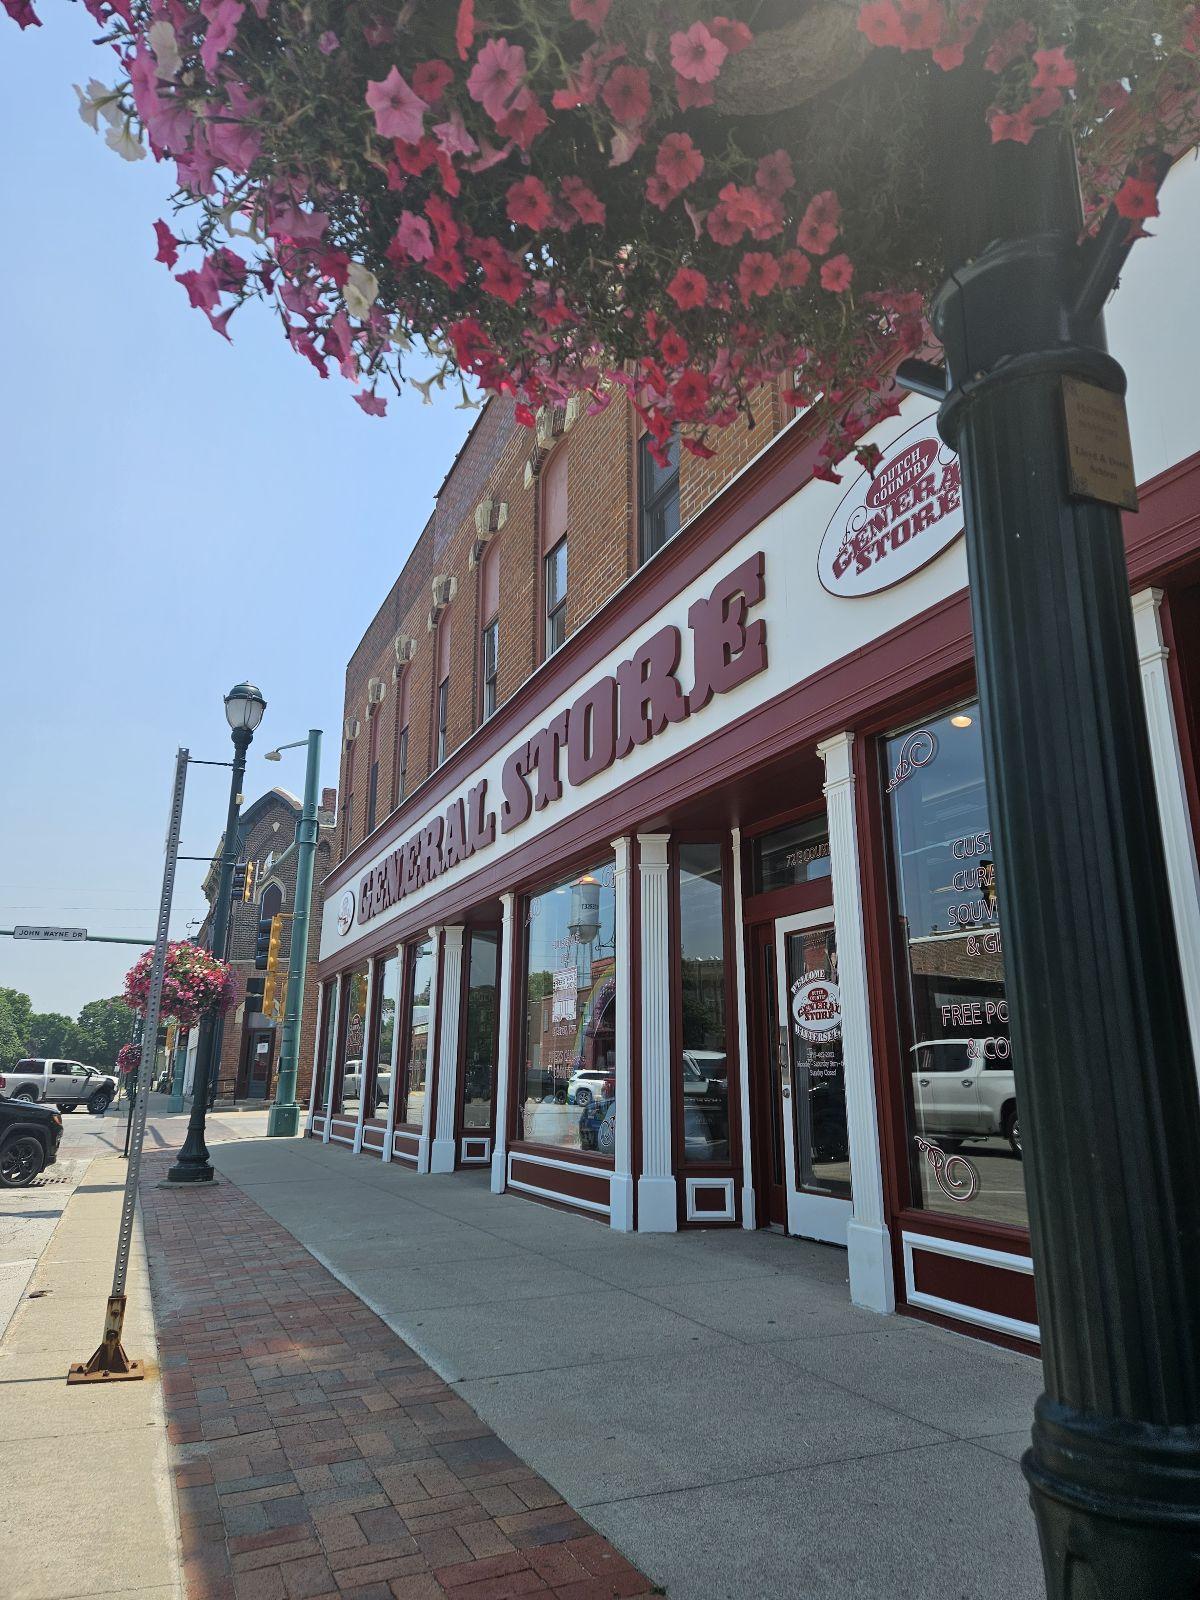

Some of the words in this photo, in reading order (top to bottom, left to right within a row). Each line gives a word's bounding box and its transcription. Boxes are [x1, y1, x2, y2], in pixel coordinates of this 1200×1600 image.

[873, 455, 930, 506] COUNTRY
[880, 447, 921, 488] DUTCH
[832, 461, 960, 580] GENERA
[856, 488, 960, 576] STORE
[357, 779, 496, 925] GENERAL
[501, 551, 768, 834] STORE
[948, 898, 998, 926] SOUV
[966, 935, 981, 956] &
[791, 969, 825, 994] WELCOME
[942, 1003, 982, 1027] FREE
[967, 1038, 980, 1059] &
